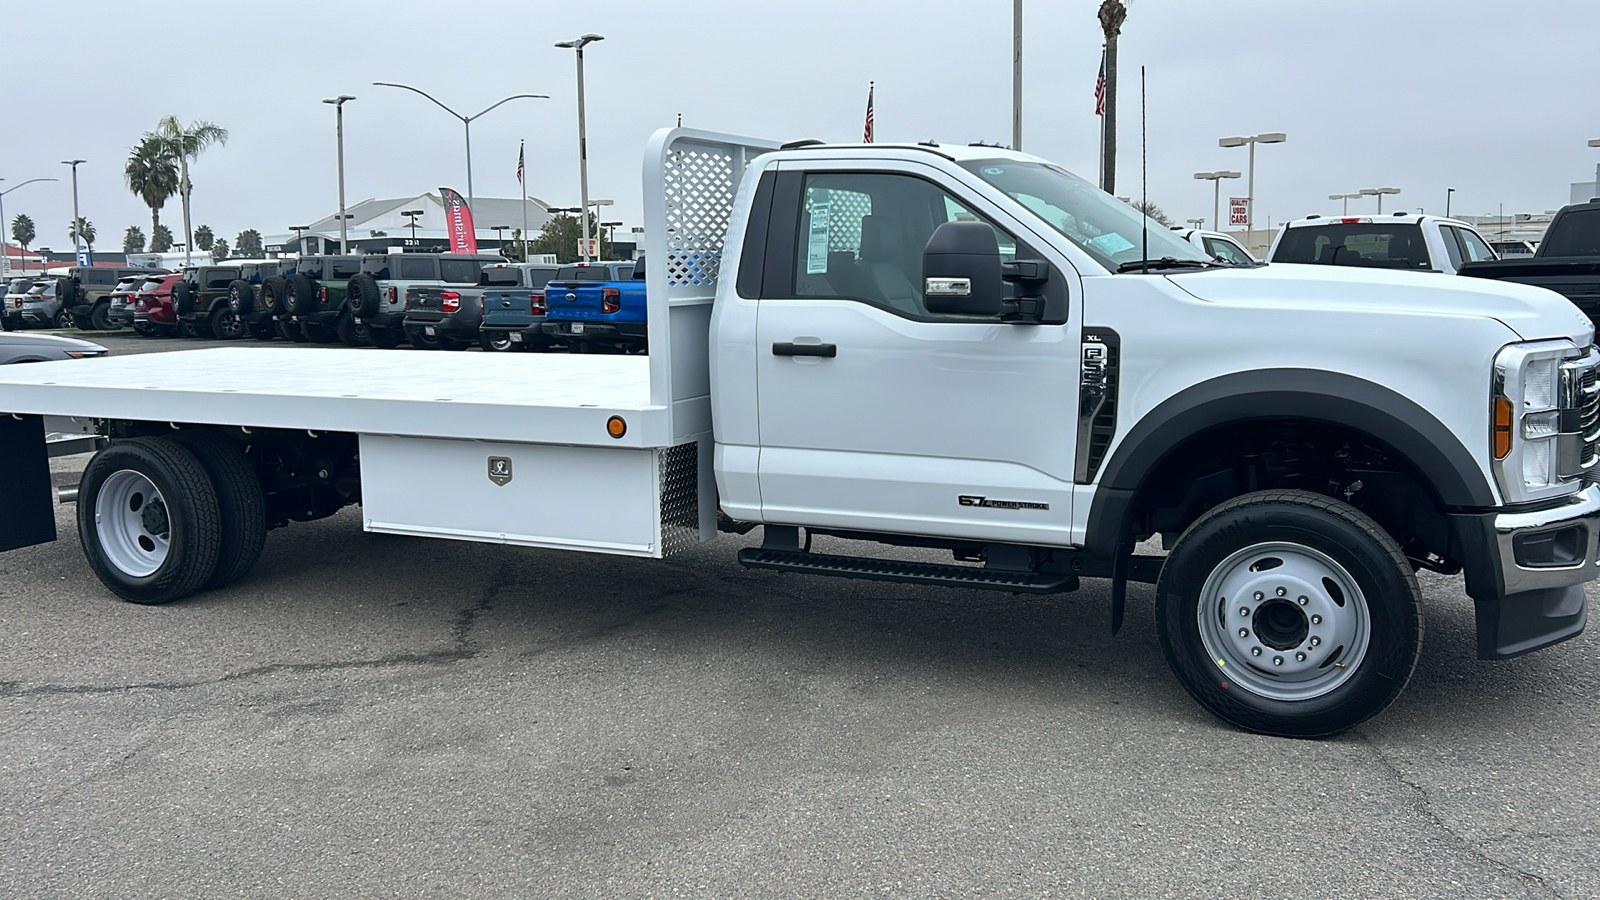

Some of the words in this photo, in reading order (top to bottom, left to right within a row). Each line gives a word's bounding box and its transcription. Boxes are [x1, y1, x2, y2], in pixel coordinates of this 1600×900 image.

[1231, 215, 1247, 223] CARS
[958, 495, 992, 508] 6.7L
[991, 500, 1017, 508] POWER
[1018, 502, 1047, 510] STROKE
